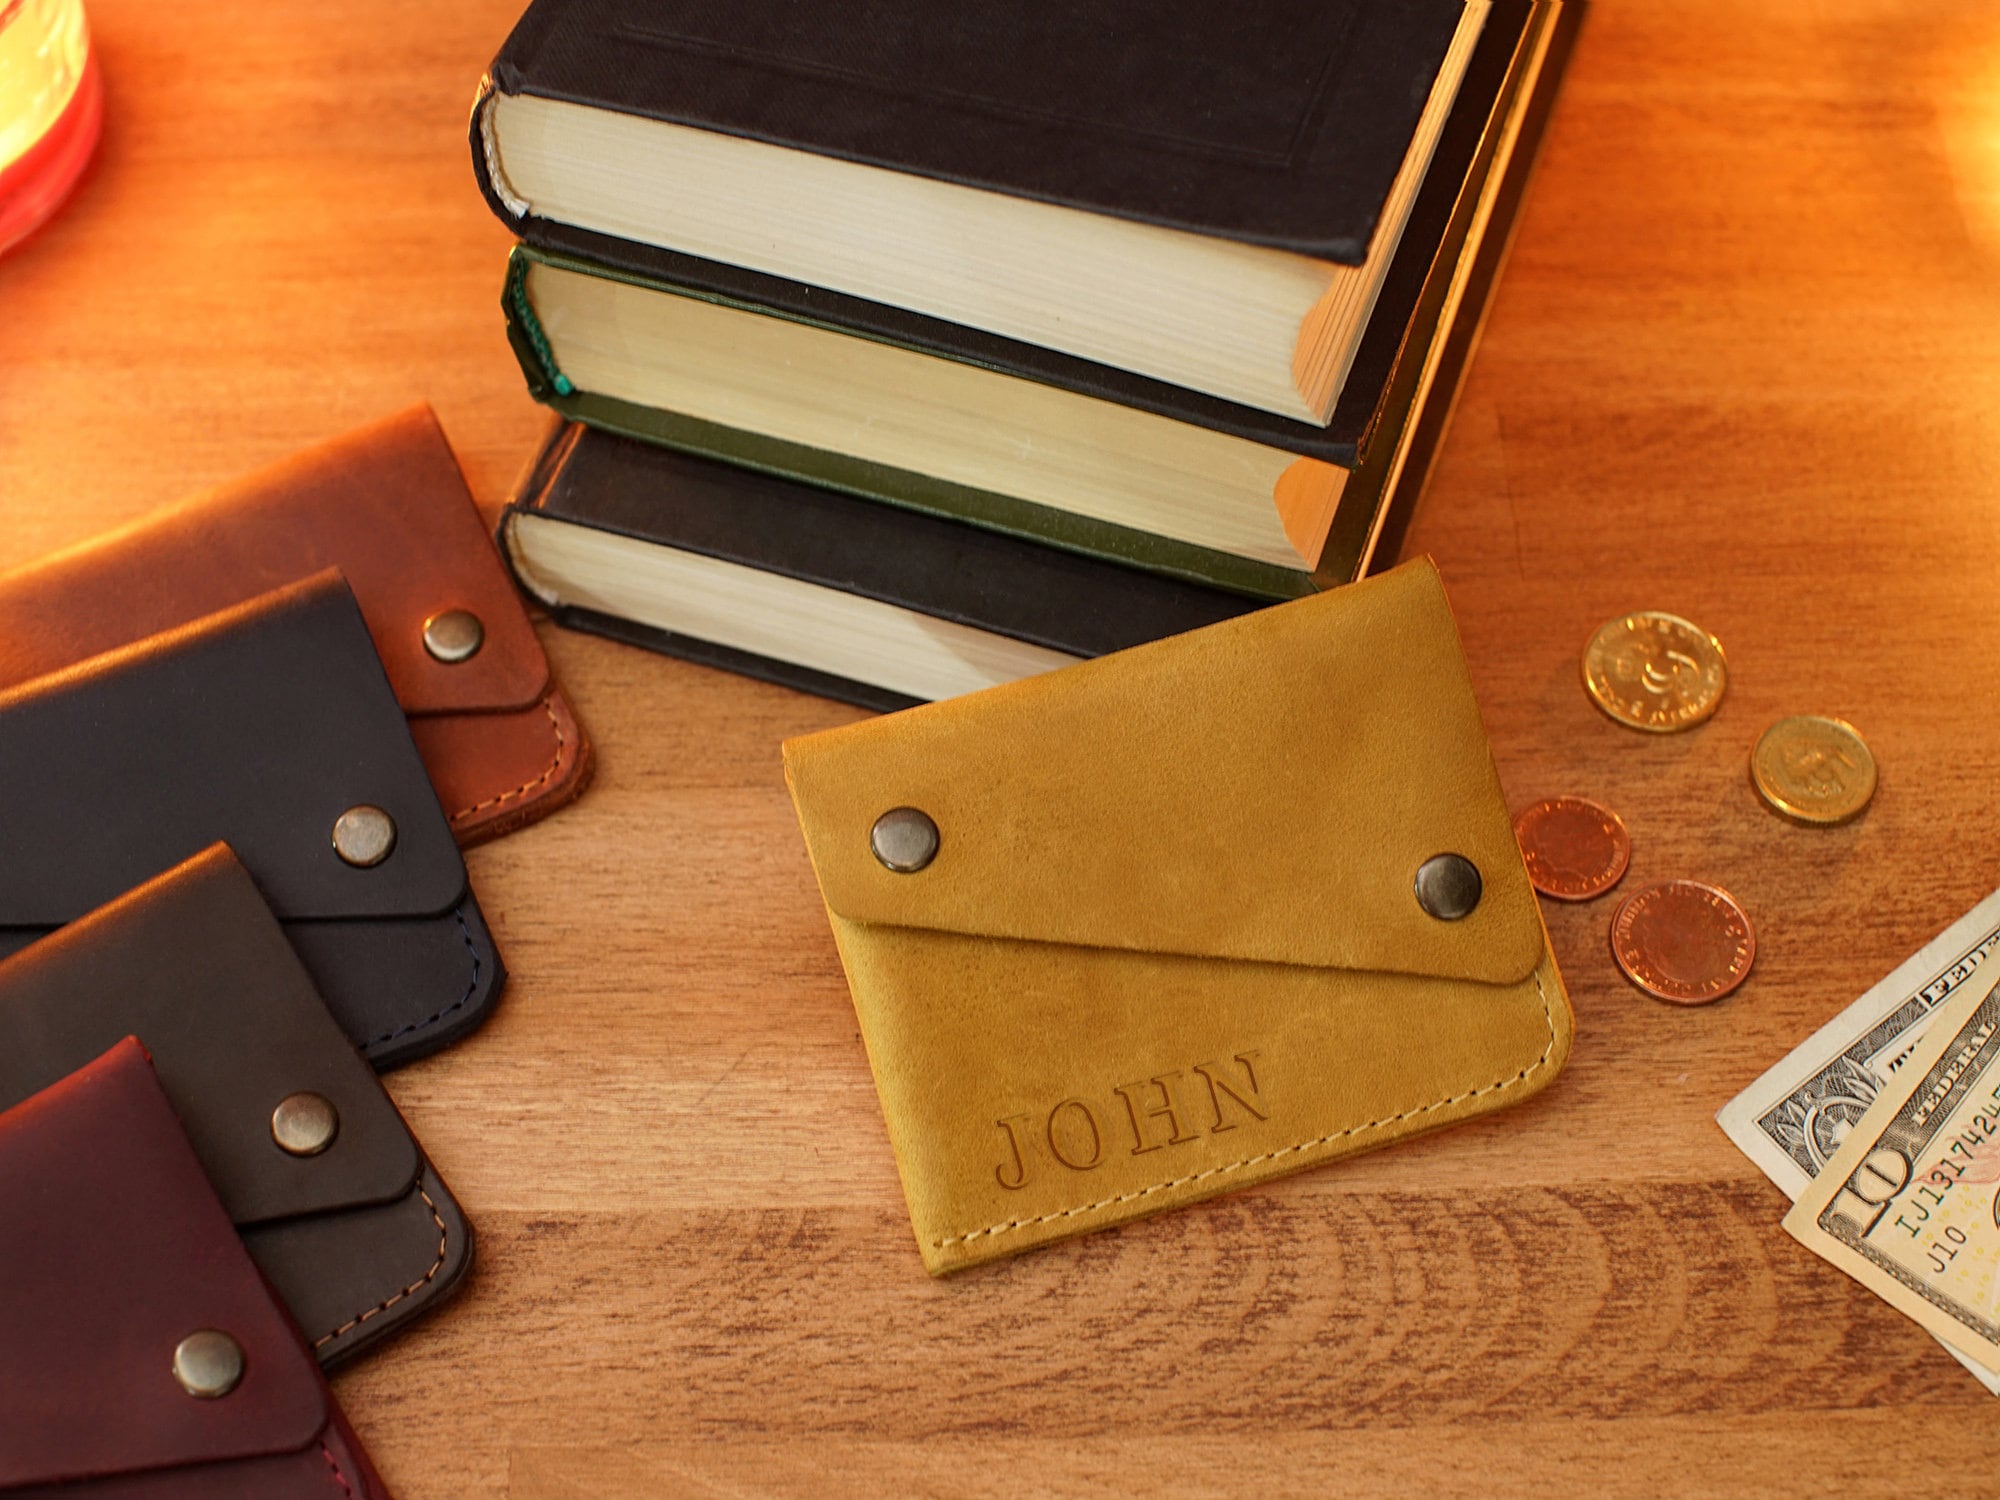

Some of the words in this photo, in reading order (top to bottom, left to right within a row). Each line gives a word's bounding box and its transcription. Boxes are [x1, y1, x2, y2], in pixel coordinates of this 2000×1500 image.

[995, 1050, 1268, 1190] JOHN
[1911, 1020, 1998, 1127] FEDERAL
[1831, 1149, 1914, 1238] 10
[1926, 1226, 1967, 1273] J10
